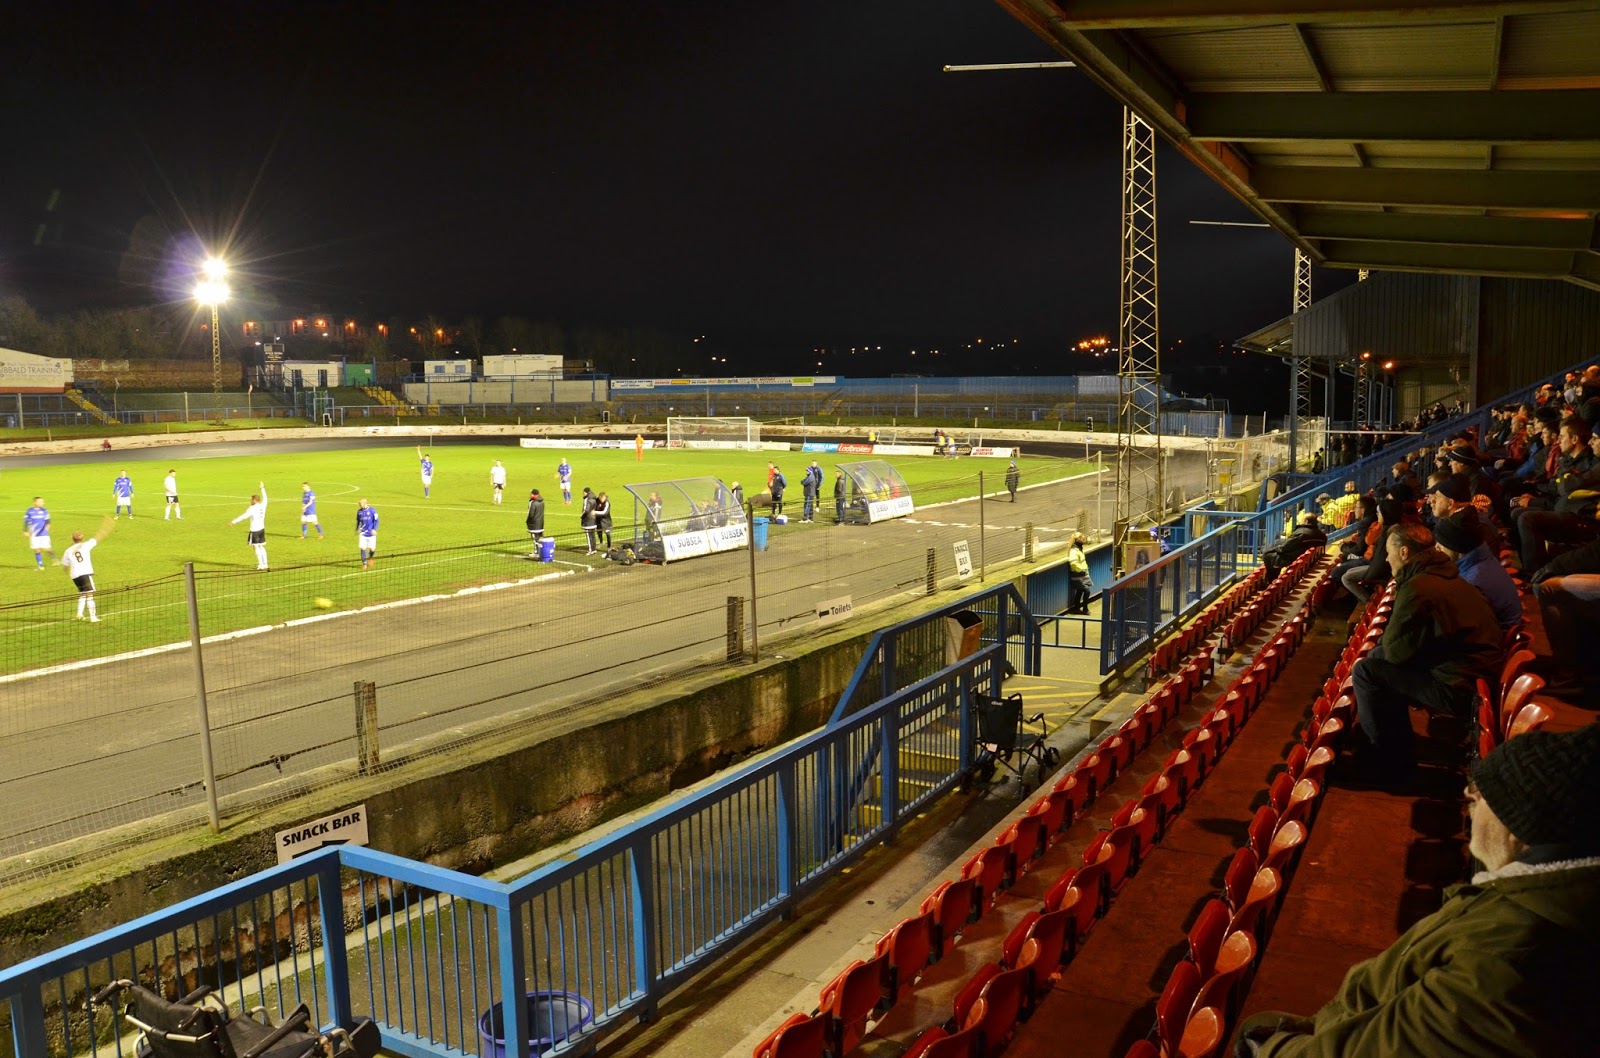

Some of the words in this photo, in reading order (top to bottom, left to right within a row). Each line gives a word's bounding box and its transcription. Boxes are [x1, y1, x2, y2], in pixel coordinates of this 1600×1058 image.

[0, 366, 27, 374] IBBALD
[28, 366, 62, 374] TRAINING
[721, 528, 745, 540] SUBSEA
[677, 536, 703, 548] SUBSEA
[75, 551, 83, 562] 8
[830, 603, 852, 615] Toilets
[282, 821, 330, 847] SNACK
[332, 812, 361, 830] BAR
